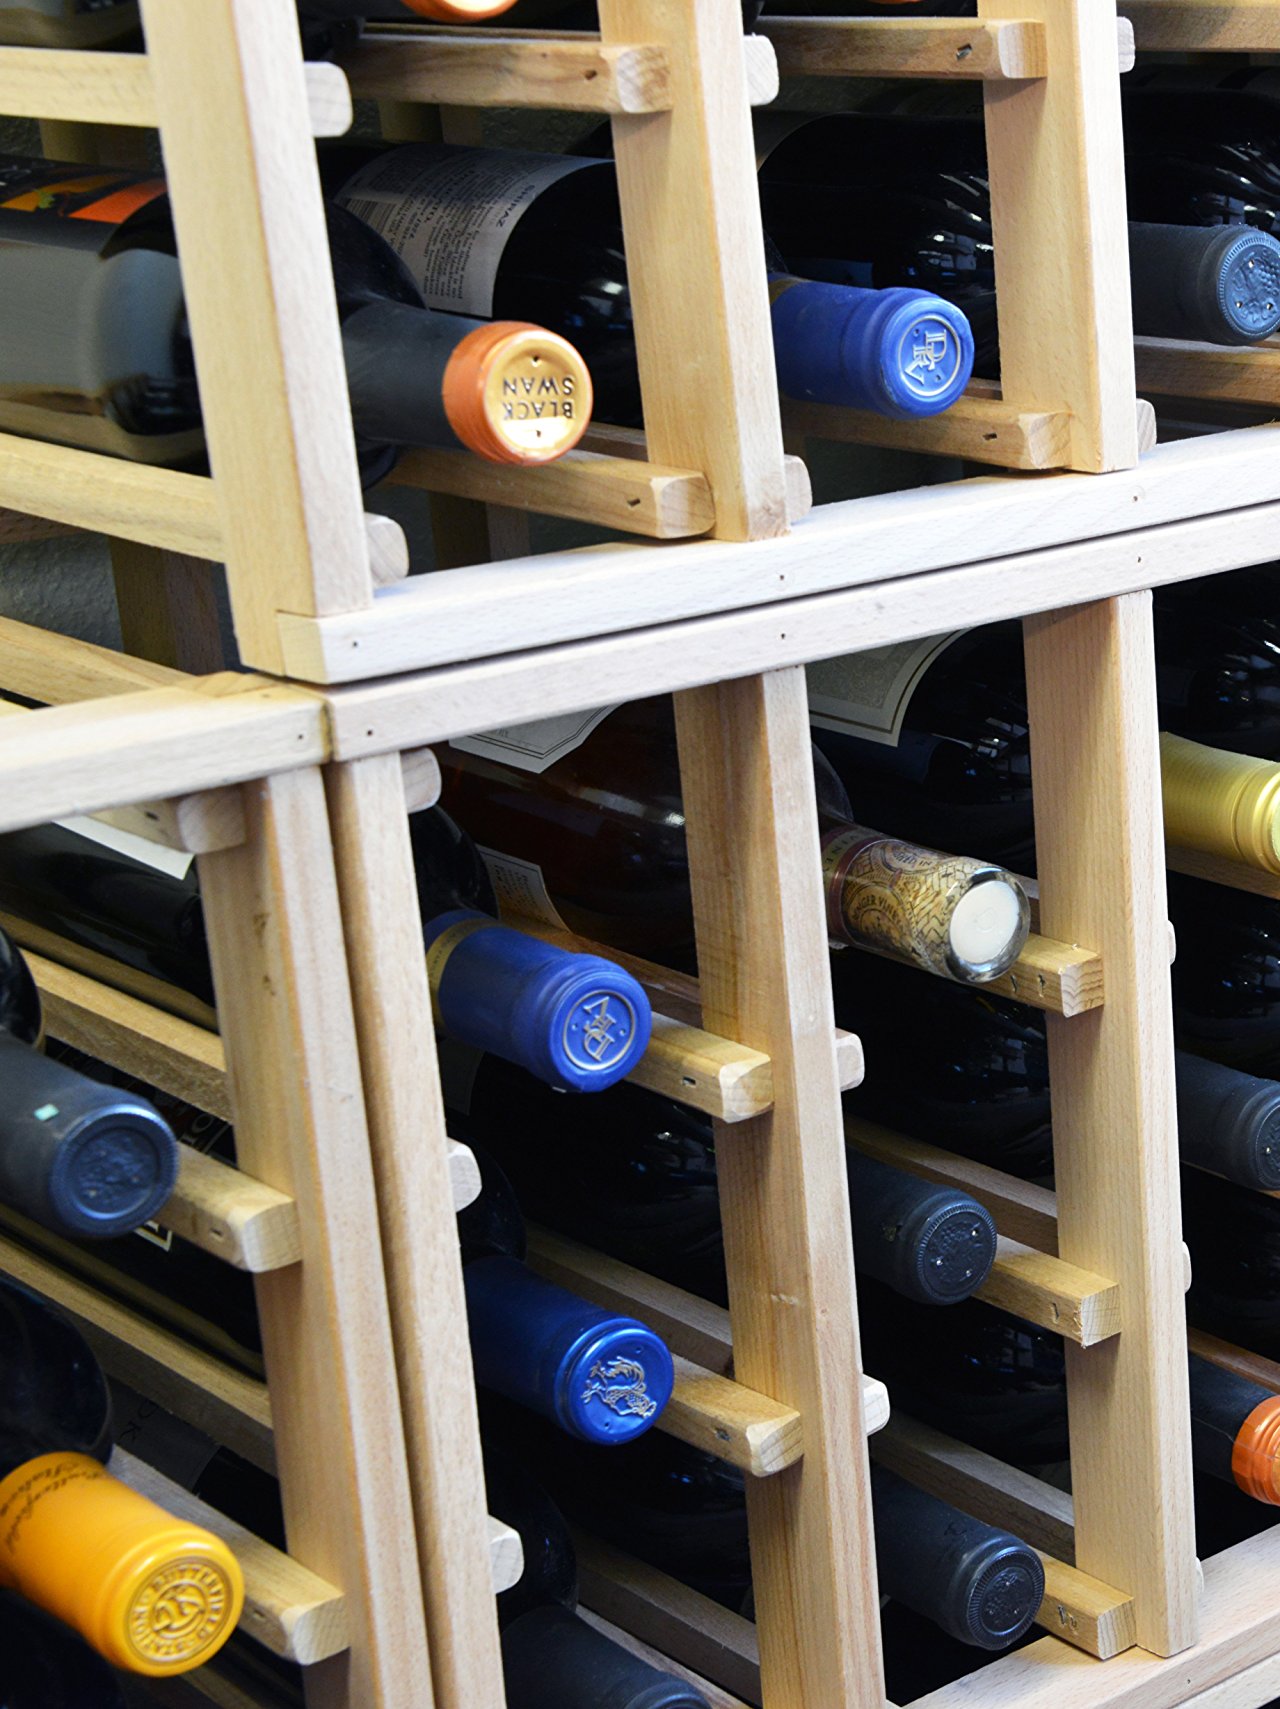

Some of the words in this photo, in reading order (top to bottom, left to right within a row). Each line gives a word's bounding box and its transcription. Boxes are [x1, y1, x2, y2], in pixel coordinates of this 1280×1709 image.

[496, 184, 536, 228] SHIRAZ
[503, 376, 575, 396] SWAN
[503, 400, 574, 421] BLACK
